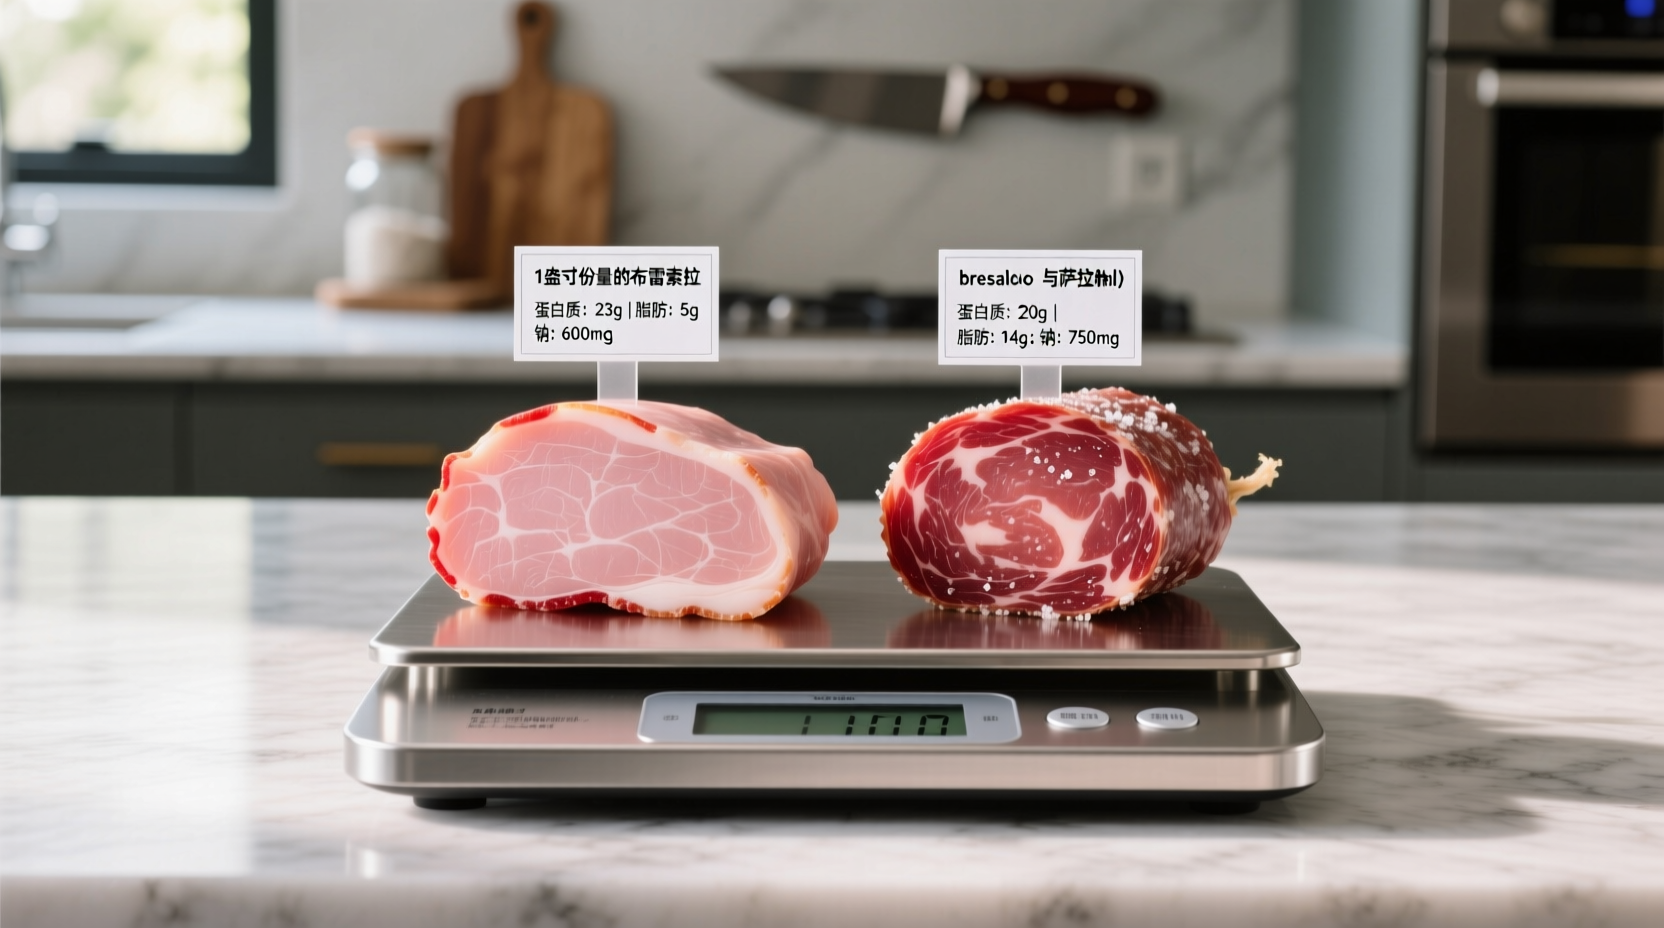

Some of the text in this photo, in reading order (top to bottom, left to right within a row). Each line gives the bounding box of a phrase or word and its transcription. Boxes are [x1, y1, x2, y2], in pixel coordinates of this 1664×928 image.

[595, 302, 623, 322] 23g
[680, 302, 699, 322] 5g
[1017, 304, 1048, 324] 20g
[561, 325, 613, 346] 600mg
[1068, 329, 1120, 350] 750mg
